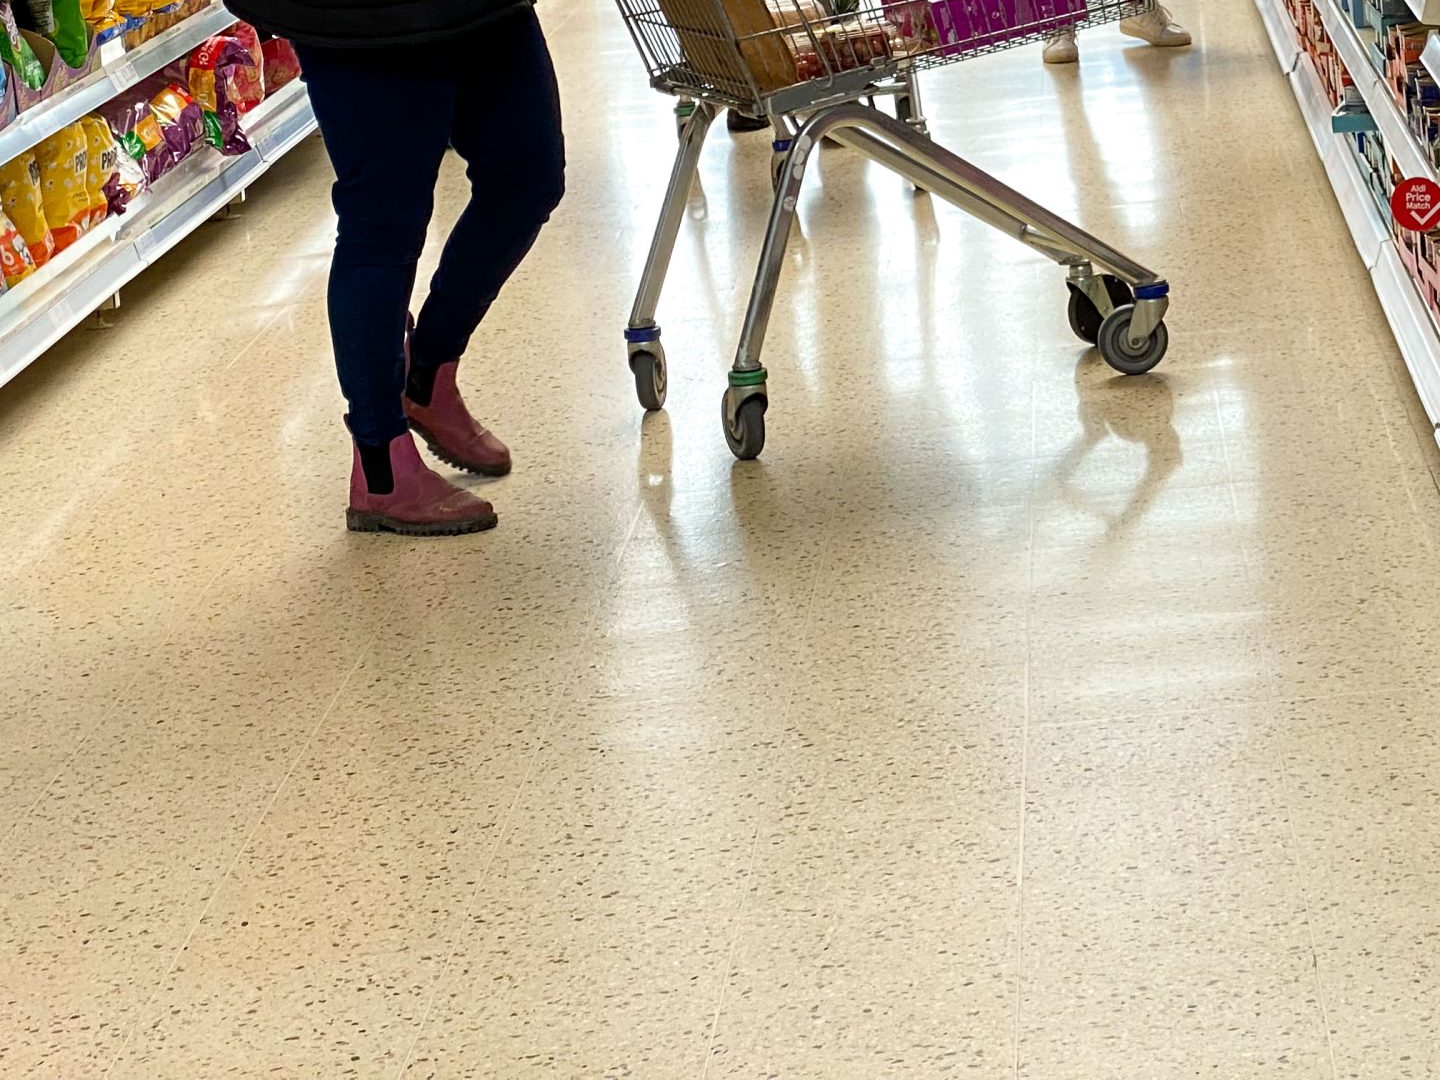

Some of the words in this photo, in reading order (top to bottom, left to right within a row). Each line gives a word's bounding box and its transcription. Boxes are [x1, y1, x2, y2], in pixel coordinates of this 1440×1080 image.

[1410, 184, 1426, 192] Aldi
[1406, 192, 1431, 202] Price
[1406, 201, 1431, 210] Match
